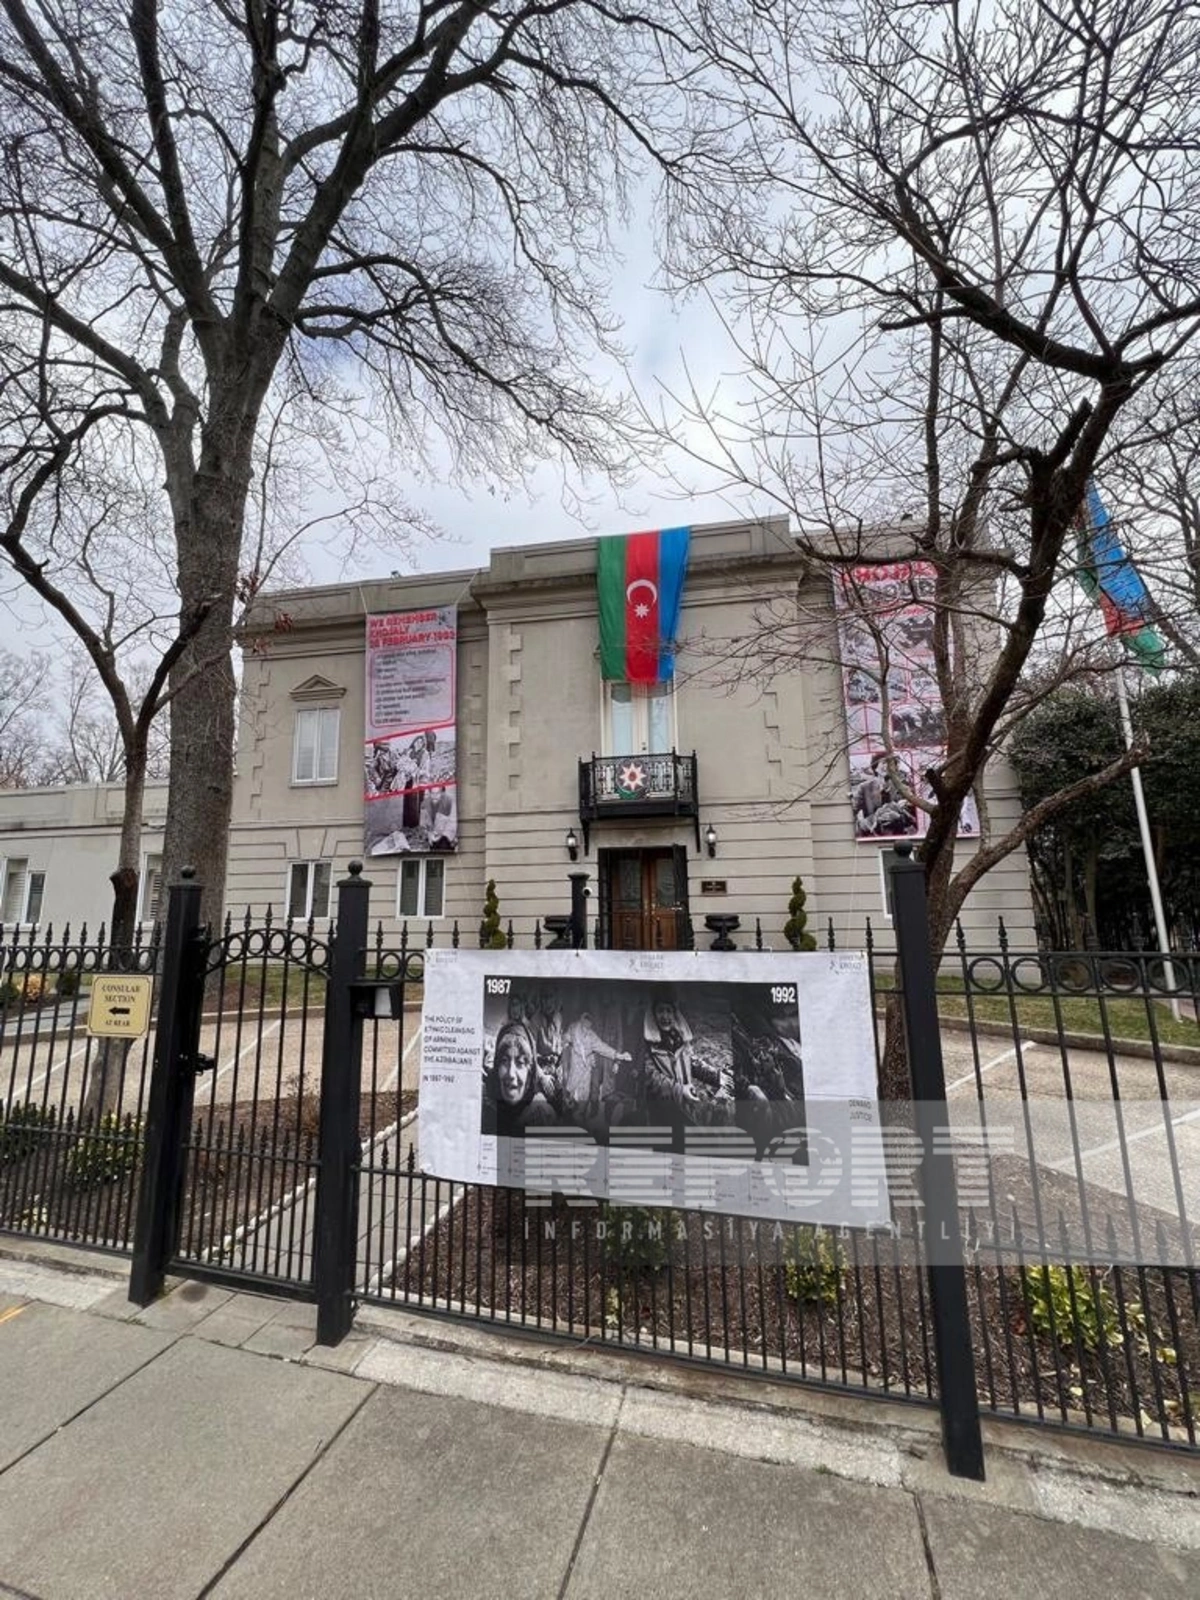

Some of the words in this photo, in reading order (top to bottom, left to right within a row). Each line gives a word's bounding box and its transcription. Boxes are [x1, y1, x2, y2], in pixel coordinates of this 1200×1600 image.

[102, 984, 140, 993] CONSULAR
[486, 978, 512, 994] 1987
[104, 994, 136, 1002] SECTION
[770, 986, 796, 1003] 1992
